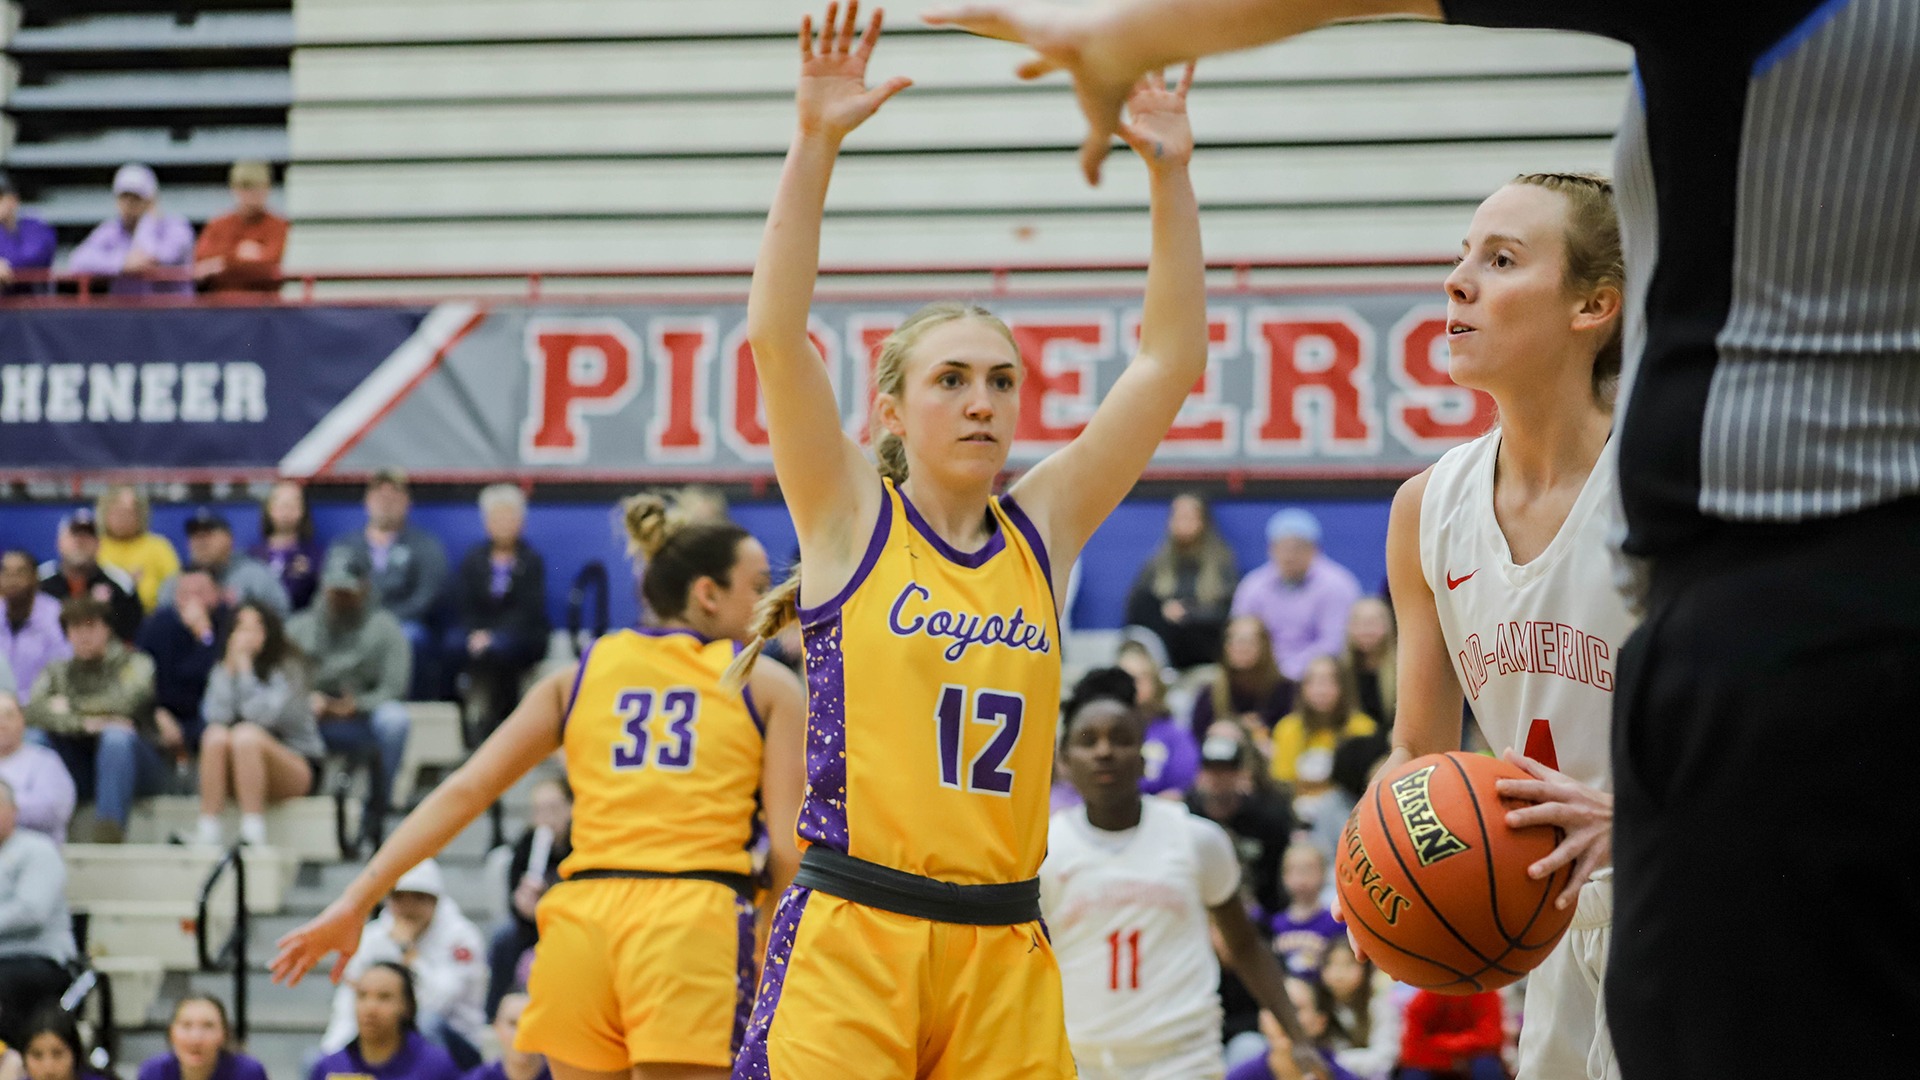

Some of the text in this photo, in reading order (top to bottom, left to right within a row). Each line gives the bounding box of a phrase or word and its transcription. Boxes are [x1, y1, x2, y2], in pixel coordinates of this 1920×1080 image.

[0, 362, 267, 423] HENEER
[519, 306, 1496, 464] PIOEERS
[888, 581, 1050, 662] Coyotes
[612, 686, 699, 772] 33
[933, 682, 1025, 797] 12
[1391, 764, 1470, 867] NAIA
[1345, 806, 1411, 927] SPALDI
[1107, 928, 1142, 991] 11
